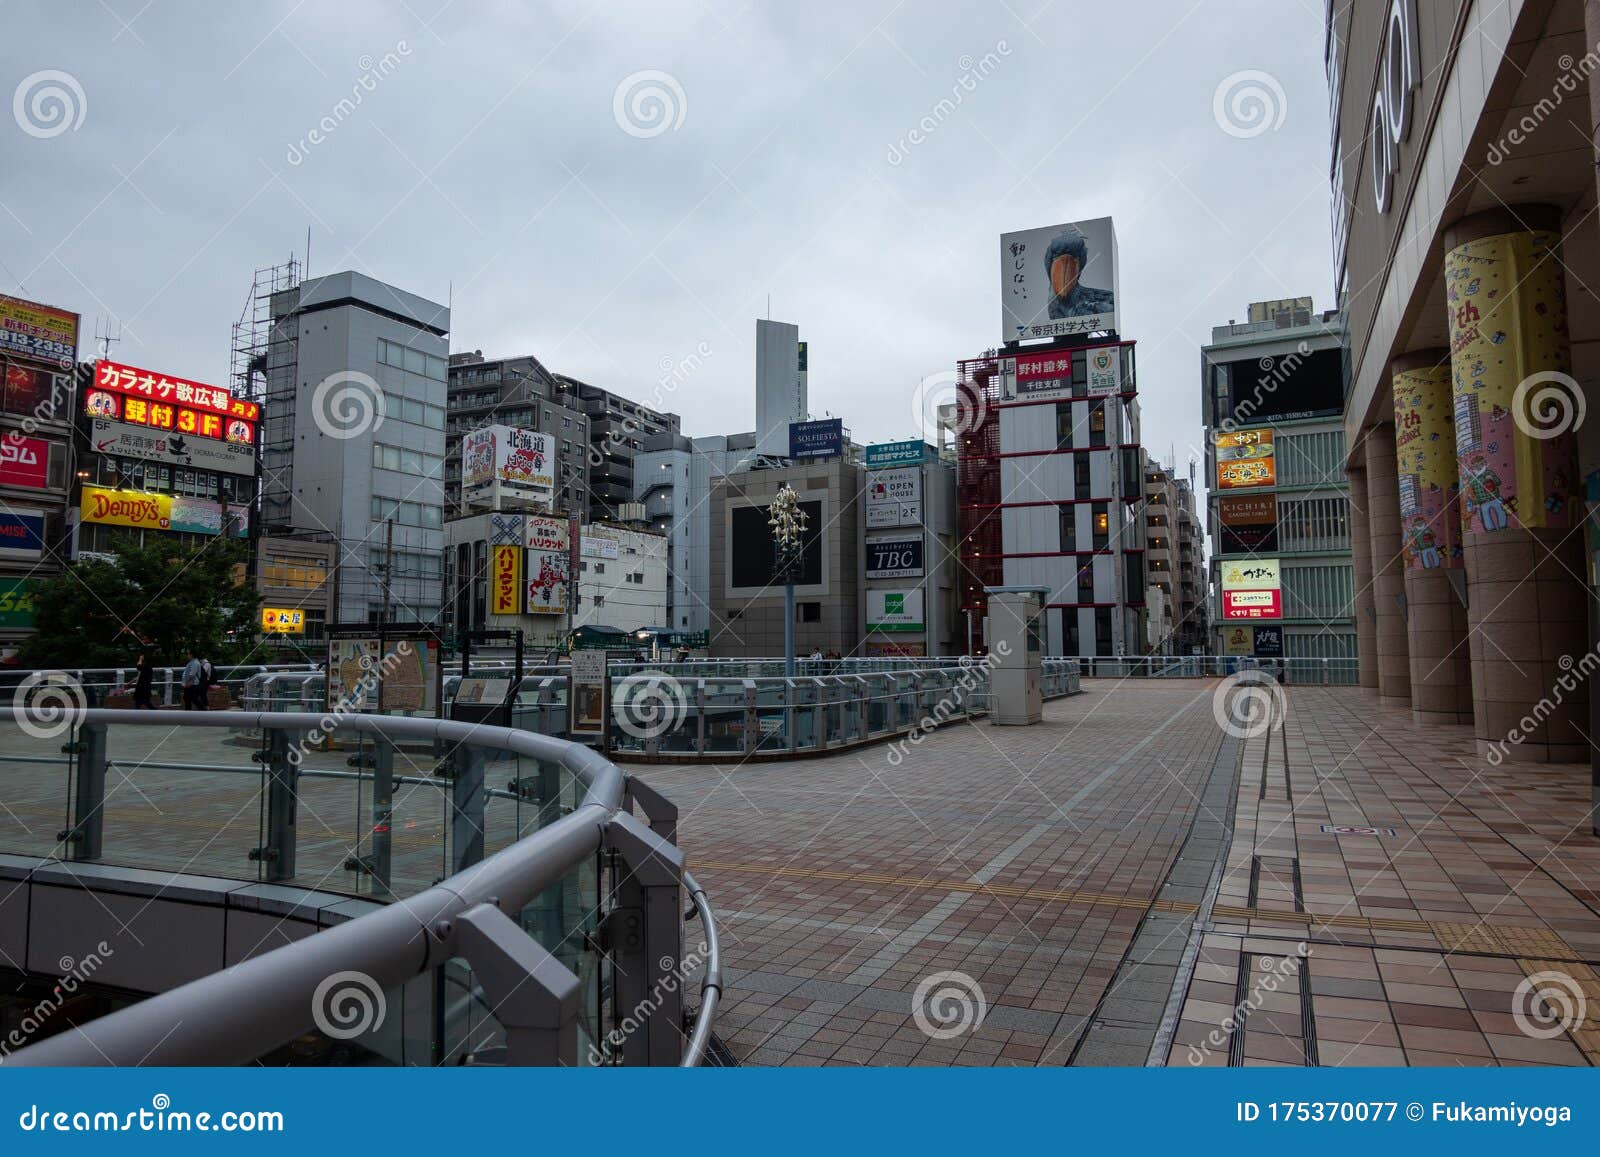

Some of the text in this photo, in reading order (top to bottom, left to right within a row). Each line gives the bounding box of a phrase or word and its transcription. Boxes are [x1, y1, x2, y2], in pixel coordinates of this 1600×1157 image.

[1031, 318, 1101, 336] 帝京科学大学
[101, 365, 228, 411] カラオケ歌広場
[1026, 379, 1061, 390] 千住支店
[95, 420, 111, 431] 5F
[507, 431, 545, 453] 北海道
[1222, 467, 1270, 479] 北海道
[890, 482, 914, 490] OPEN
[92, 494, 160, 522] Denny's
[902, 507, 916, 517] 2F
[1223, 502, 1273, 511] KICHIRI
[529, 538, 565, 549] ハリウッド
[874, 551, 913, 569] TBC
[499, 549, 514, 609] ハリウッド
[279, 613, 300, 624] 松屋
[1230, 609, 1247, 617] くすり
[1256, 630, 1280, 645] 大戸屋
